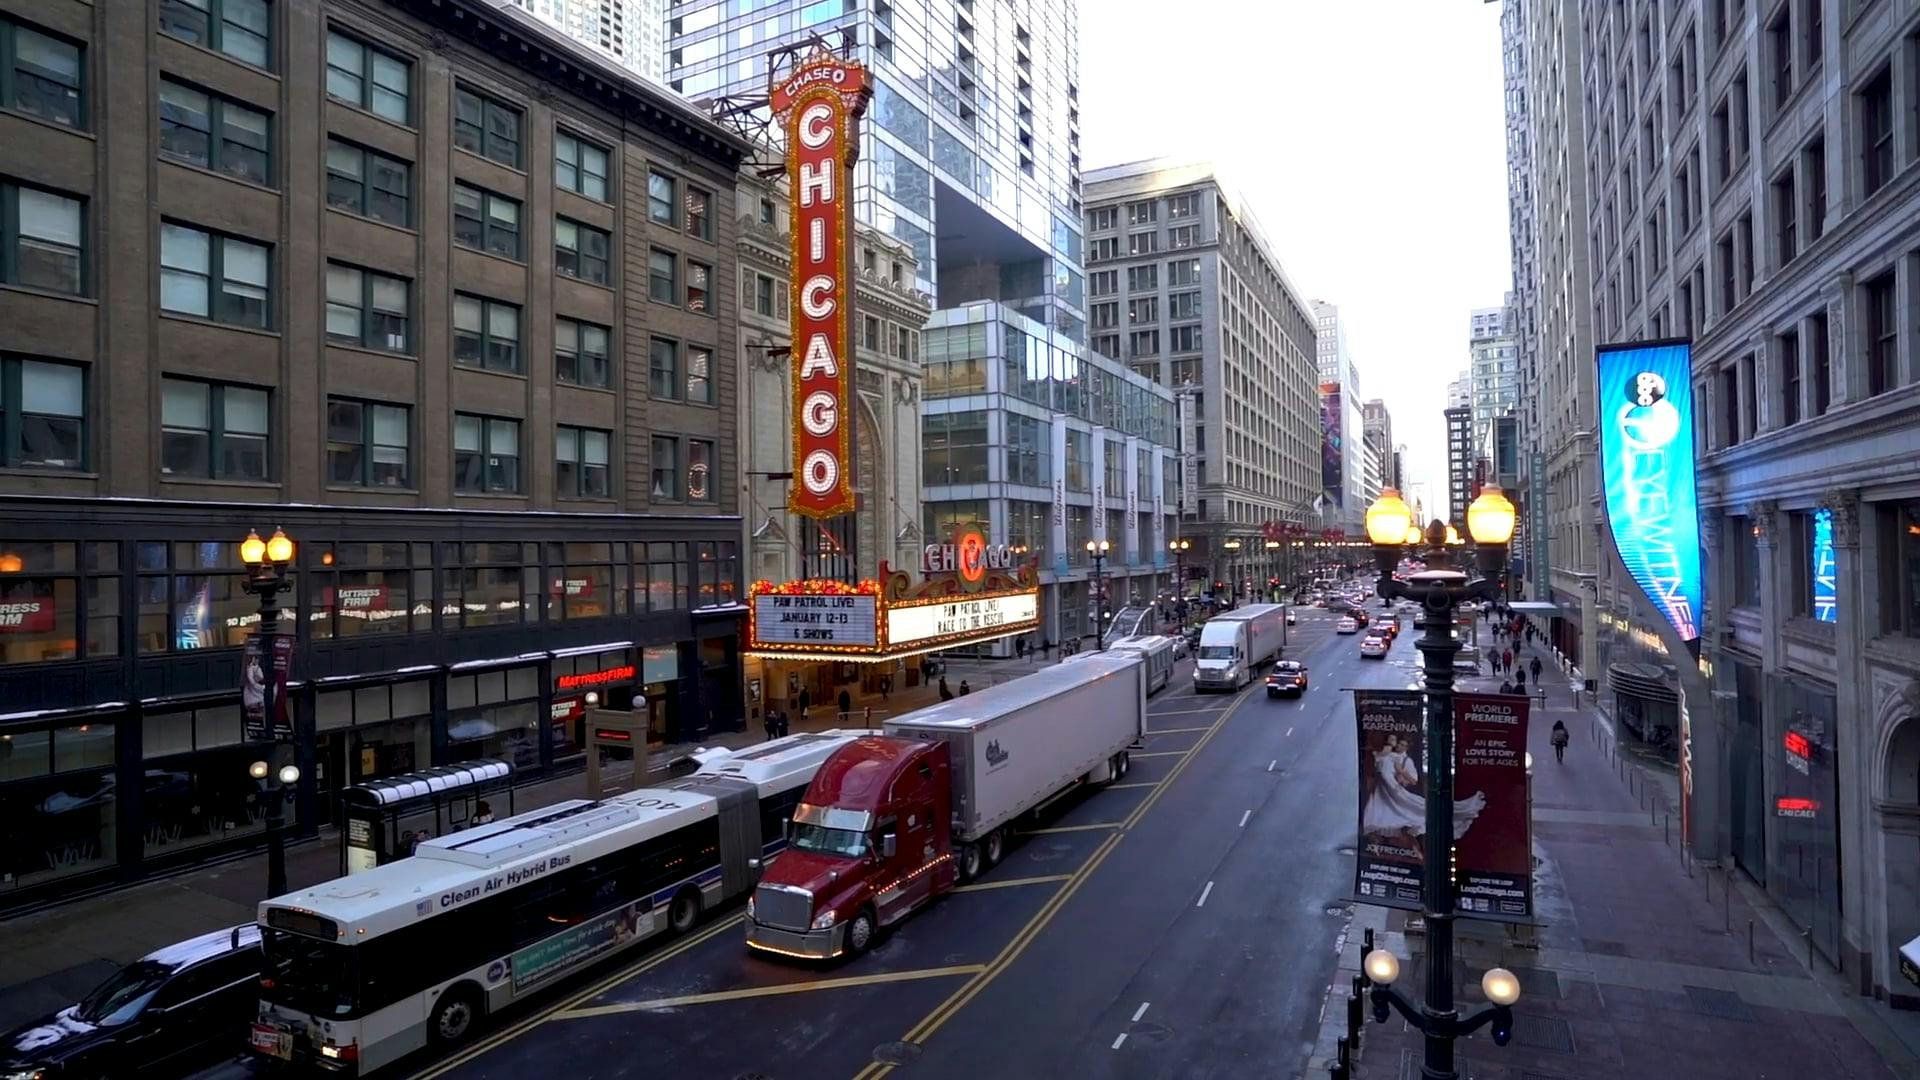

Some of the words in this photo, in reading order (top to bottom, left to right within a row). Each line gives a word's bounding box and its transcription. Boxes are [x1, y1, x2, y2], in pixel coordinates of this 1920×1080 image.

[784, 67, 832, 97] CHASE
[798, 103, 840, 497] CHICAGO
[343, 597, 371, 607] FIRM
[773, 596, 792, 608] PAW
[794, 596, 828, 608] PATROL
[943, 604, 957, 618] PAW
[780, 612, 821, 624] JANUARY
[825, 613, 849, 625] 12-13
[937, 617, 955, 634] RACE
[983, 613, 1005, 627] RESCUE
[802, 628, 834, 640] SHOWS
[1471, 704, 1512, 715] WORLD
[1361, 713, 1395, 723] ANNA
[1464, 712, 1519, 725] PREMIERE
[1362, 722, 1418, 733] KARENINA
[1474, 739, 1487, 747] AN
[1488, 740, 1507, 748] EPIC
[1465, 748, 1487, 757] LOVE
[1488, 749, 1516, 758] STORY
[1462, 758, 1478, 766] FOR
[1480, 758, 1495, 766] THE
[1496, 759, 1519, 768] AGES
[440, 886, 481, 908] Clean
[484, 877, 504, 893] Air
[507, 861, 547, 885] Hybrid
[549, 854, 571, 869] Bus
[1460, 884, 1525, 898] LoopChicago.com
